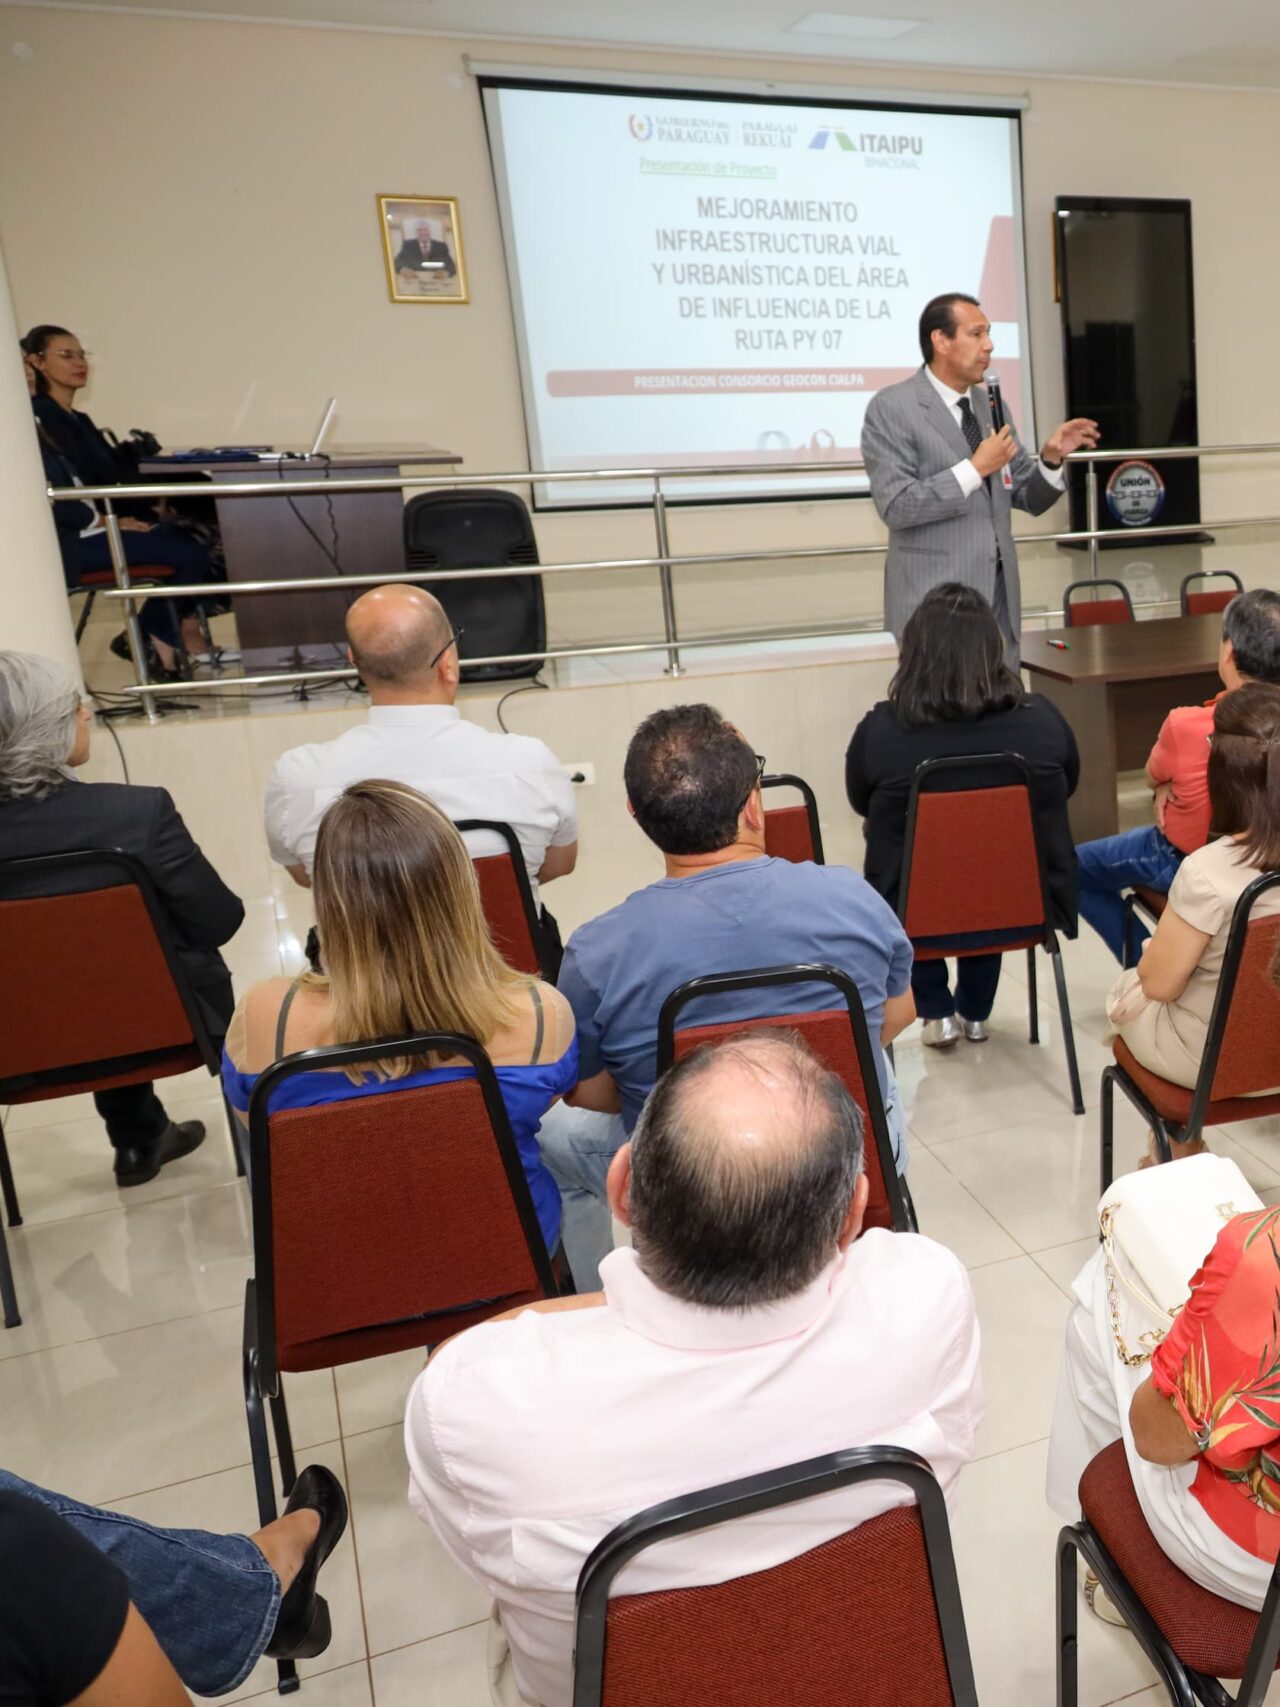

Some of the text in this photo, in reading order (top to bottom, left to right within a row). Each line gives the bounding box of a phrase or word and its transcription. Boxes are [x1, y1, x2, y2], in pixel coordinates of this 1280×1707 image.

[657, 128, 730, 145] PARAGUAY
[860, 133, 923, 155] ITAIPU
[713, 162, 730, 175] de
[697, 196, 858, 223] MEJORAMIENTO
[655, 229, 901, 256] INFRAESTRUCTURA VIAL
[651, 259, 909, 288] Y URBANÍSTICA DEL ÁREA
[679, 297, 891, 319] DE INFLUENCIA DE LA
[735, 329, 842, 350] RUTA PY 07
[718, 374, 781, 388] CONSORCIO
[1120, 475, 1151, 487] UNIÓN
